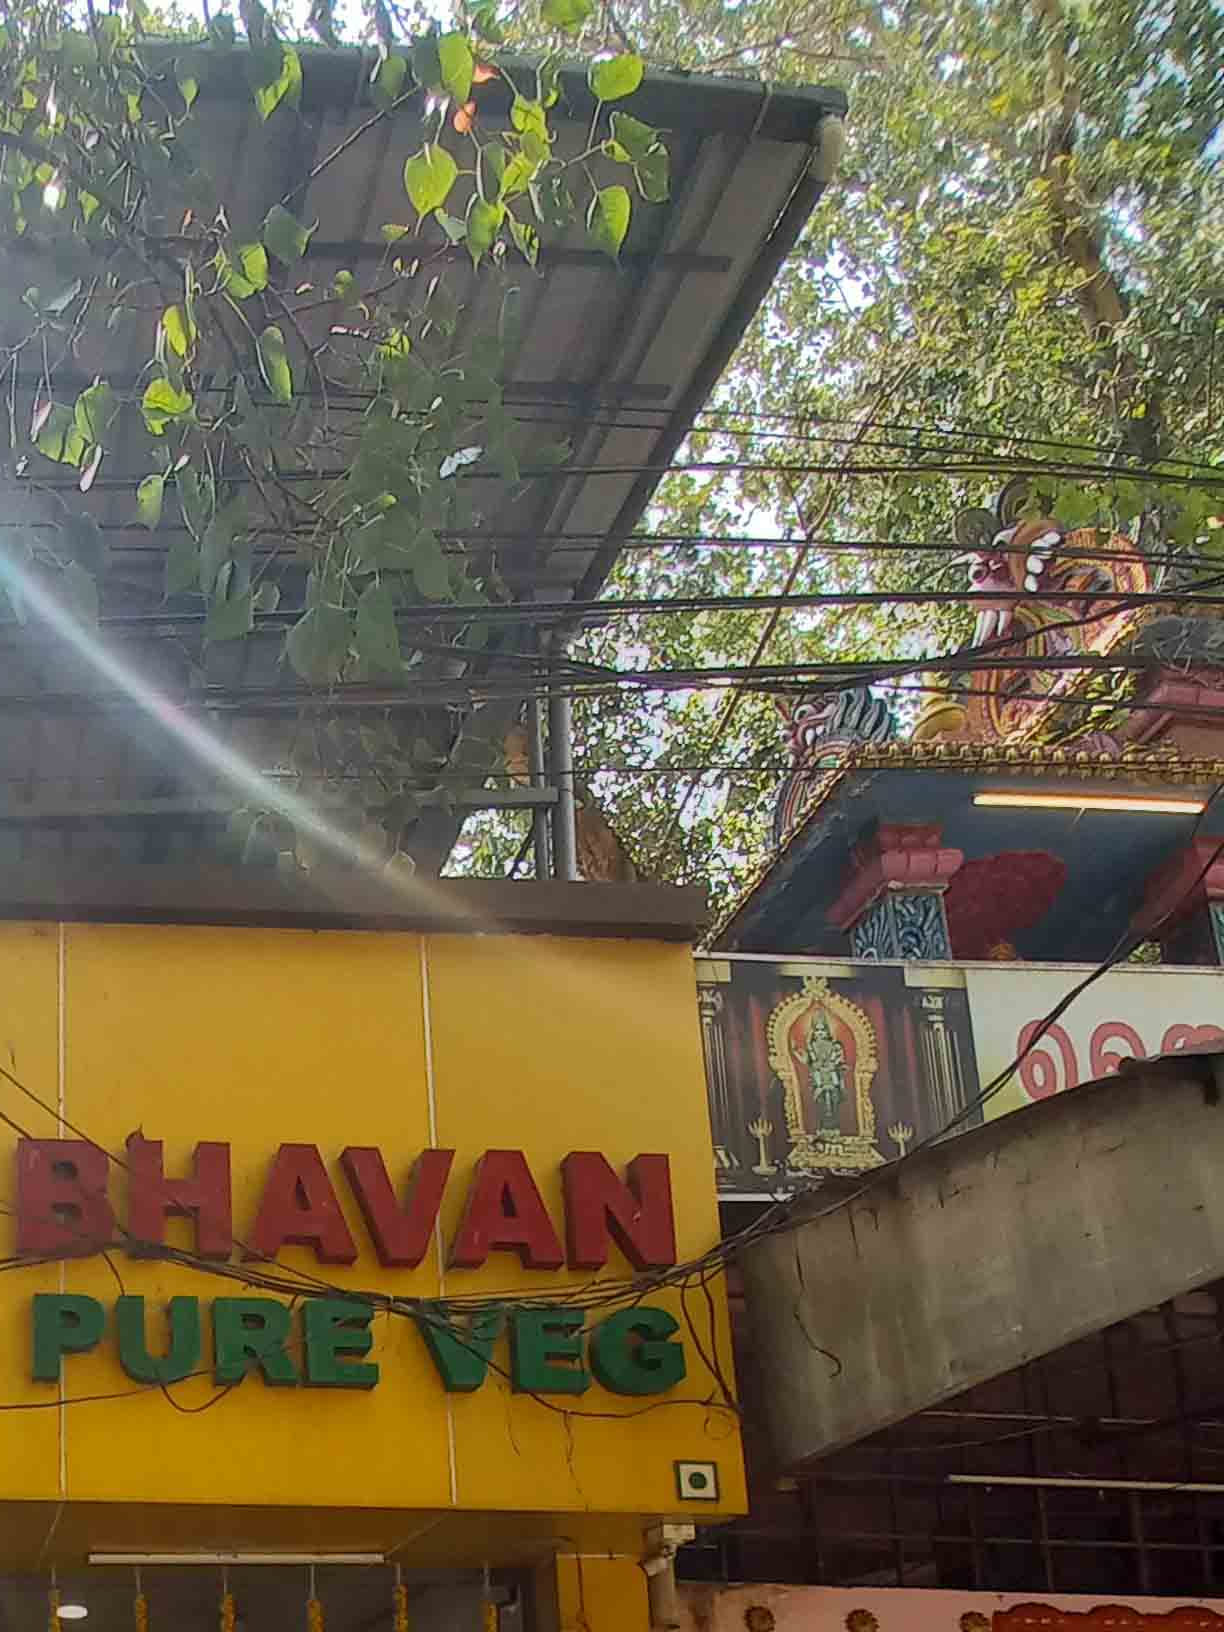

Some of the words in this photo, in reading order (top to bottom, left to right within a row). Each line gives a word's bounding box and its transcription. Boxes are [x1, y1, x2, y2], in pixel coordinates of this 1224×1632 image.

[16, 1137, 678, 1271] BHAVAN
[31, 1293, 380, 1389] PURE
[411, 1299, 688, 1396] VEG
